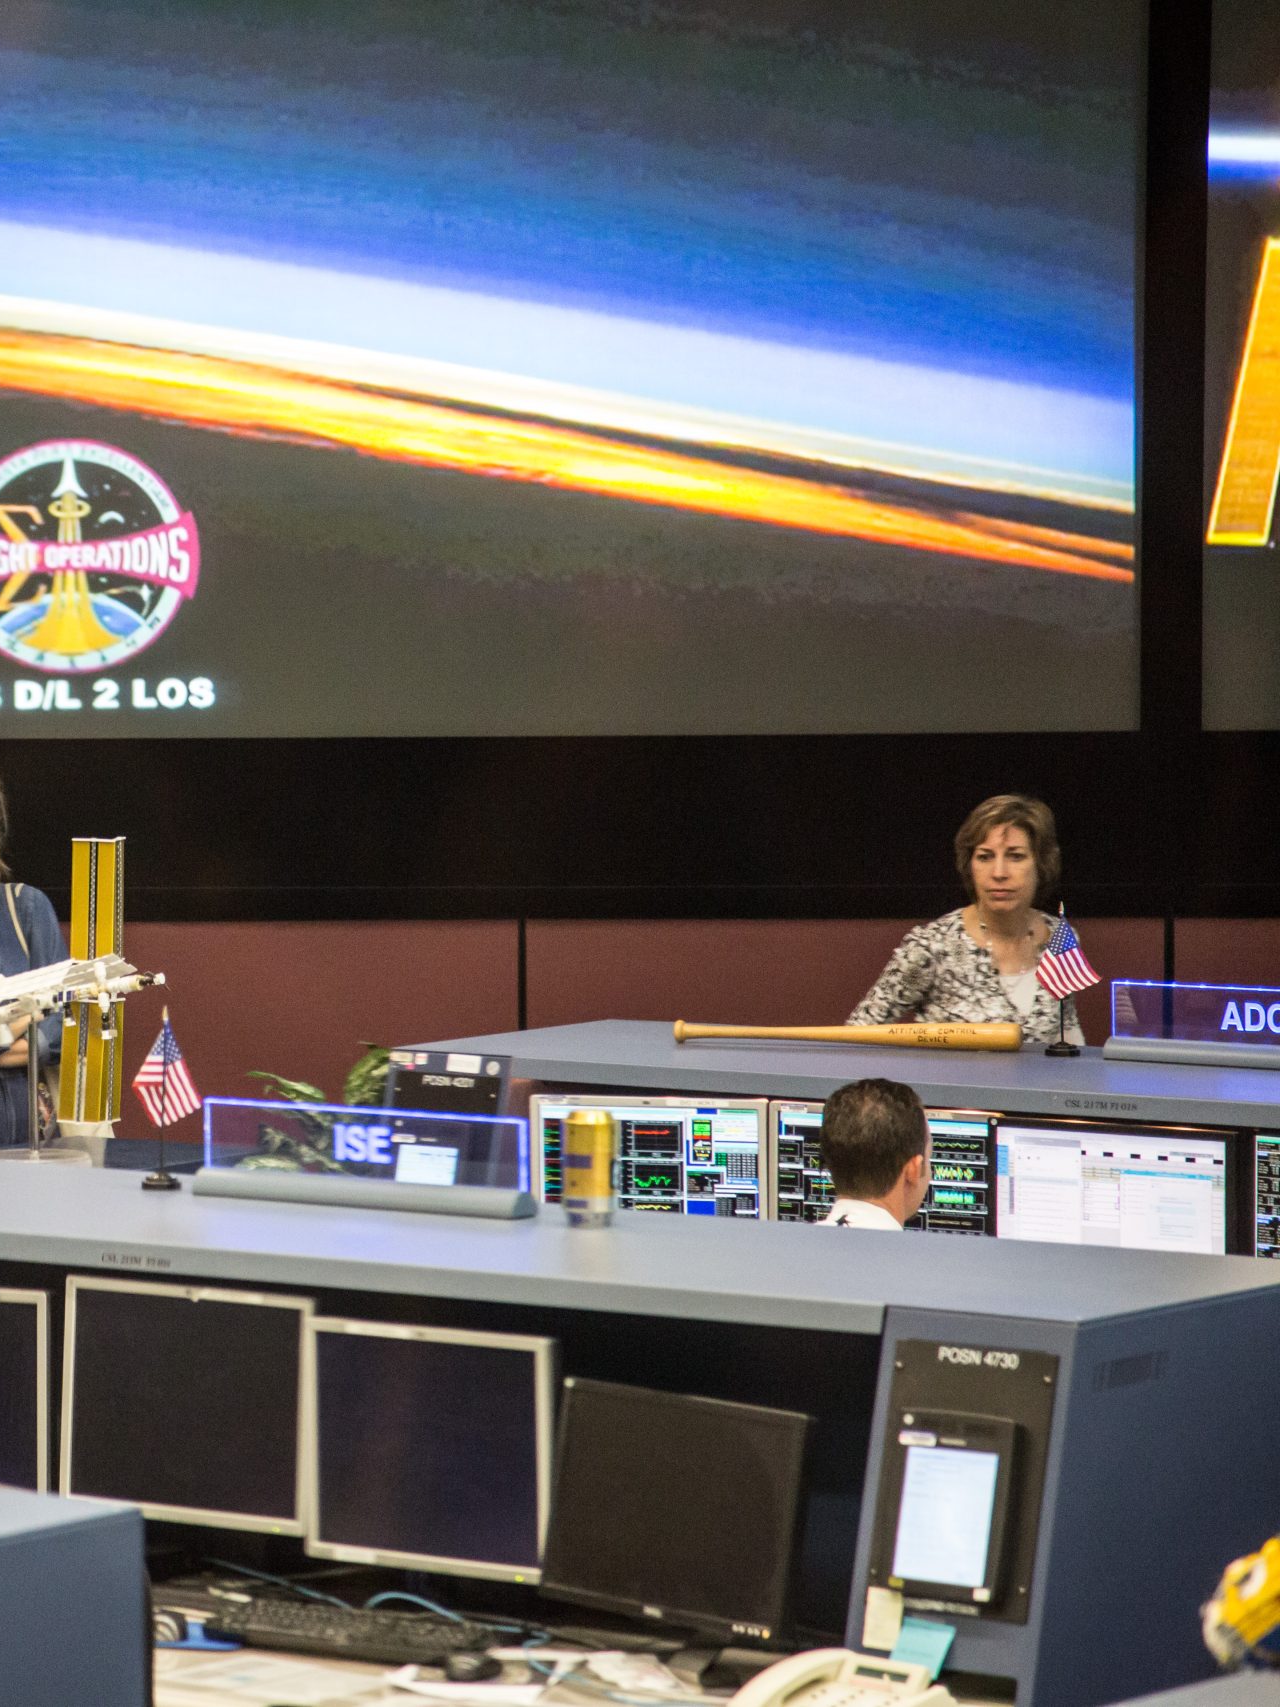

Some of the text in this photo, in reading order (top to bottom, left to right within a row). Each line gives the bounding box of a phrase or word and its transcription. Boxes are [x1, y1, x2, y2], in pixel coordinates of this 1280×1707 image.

[43, 526, 191, 583] OPERATIONS
[14, 679, 83, 711] D/L
[91, 677, 120, 709] 2
[131, 676, 216, 709] LOS
[333, 1123, 392, 1165] ISE
[937, 1346, 1019, 1370] POSN 4730
